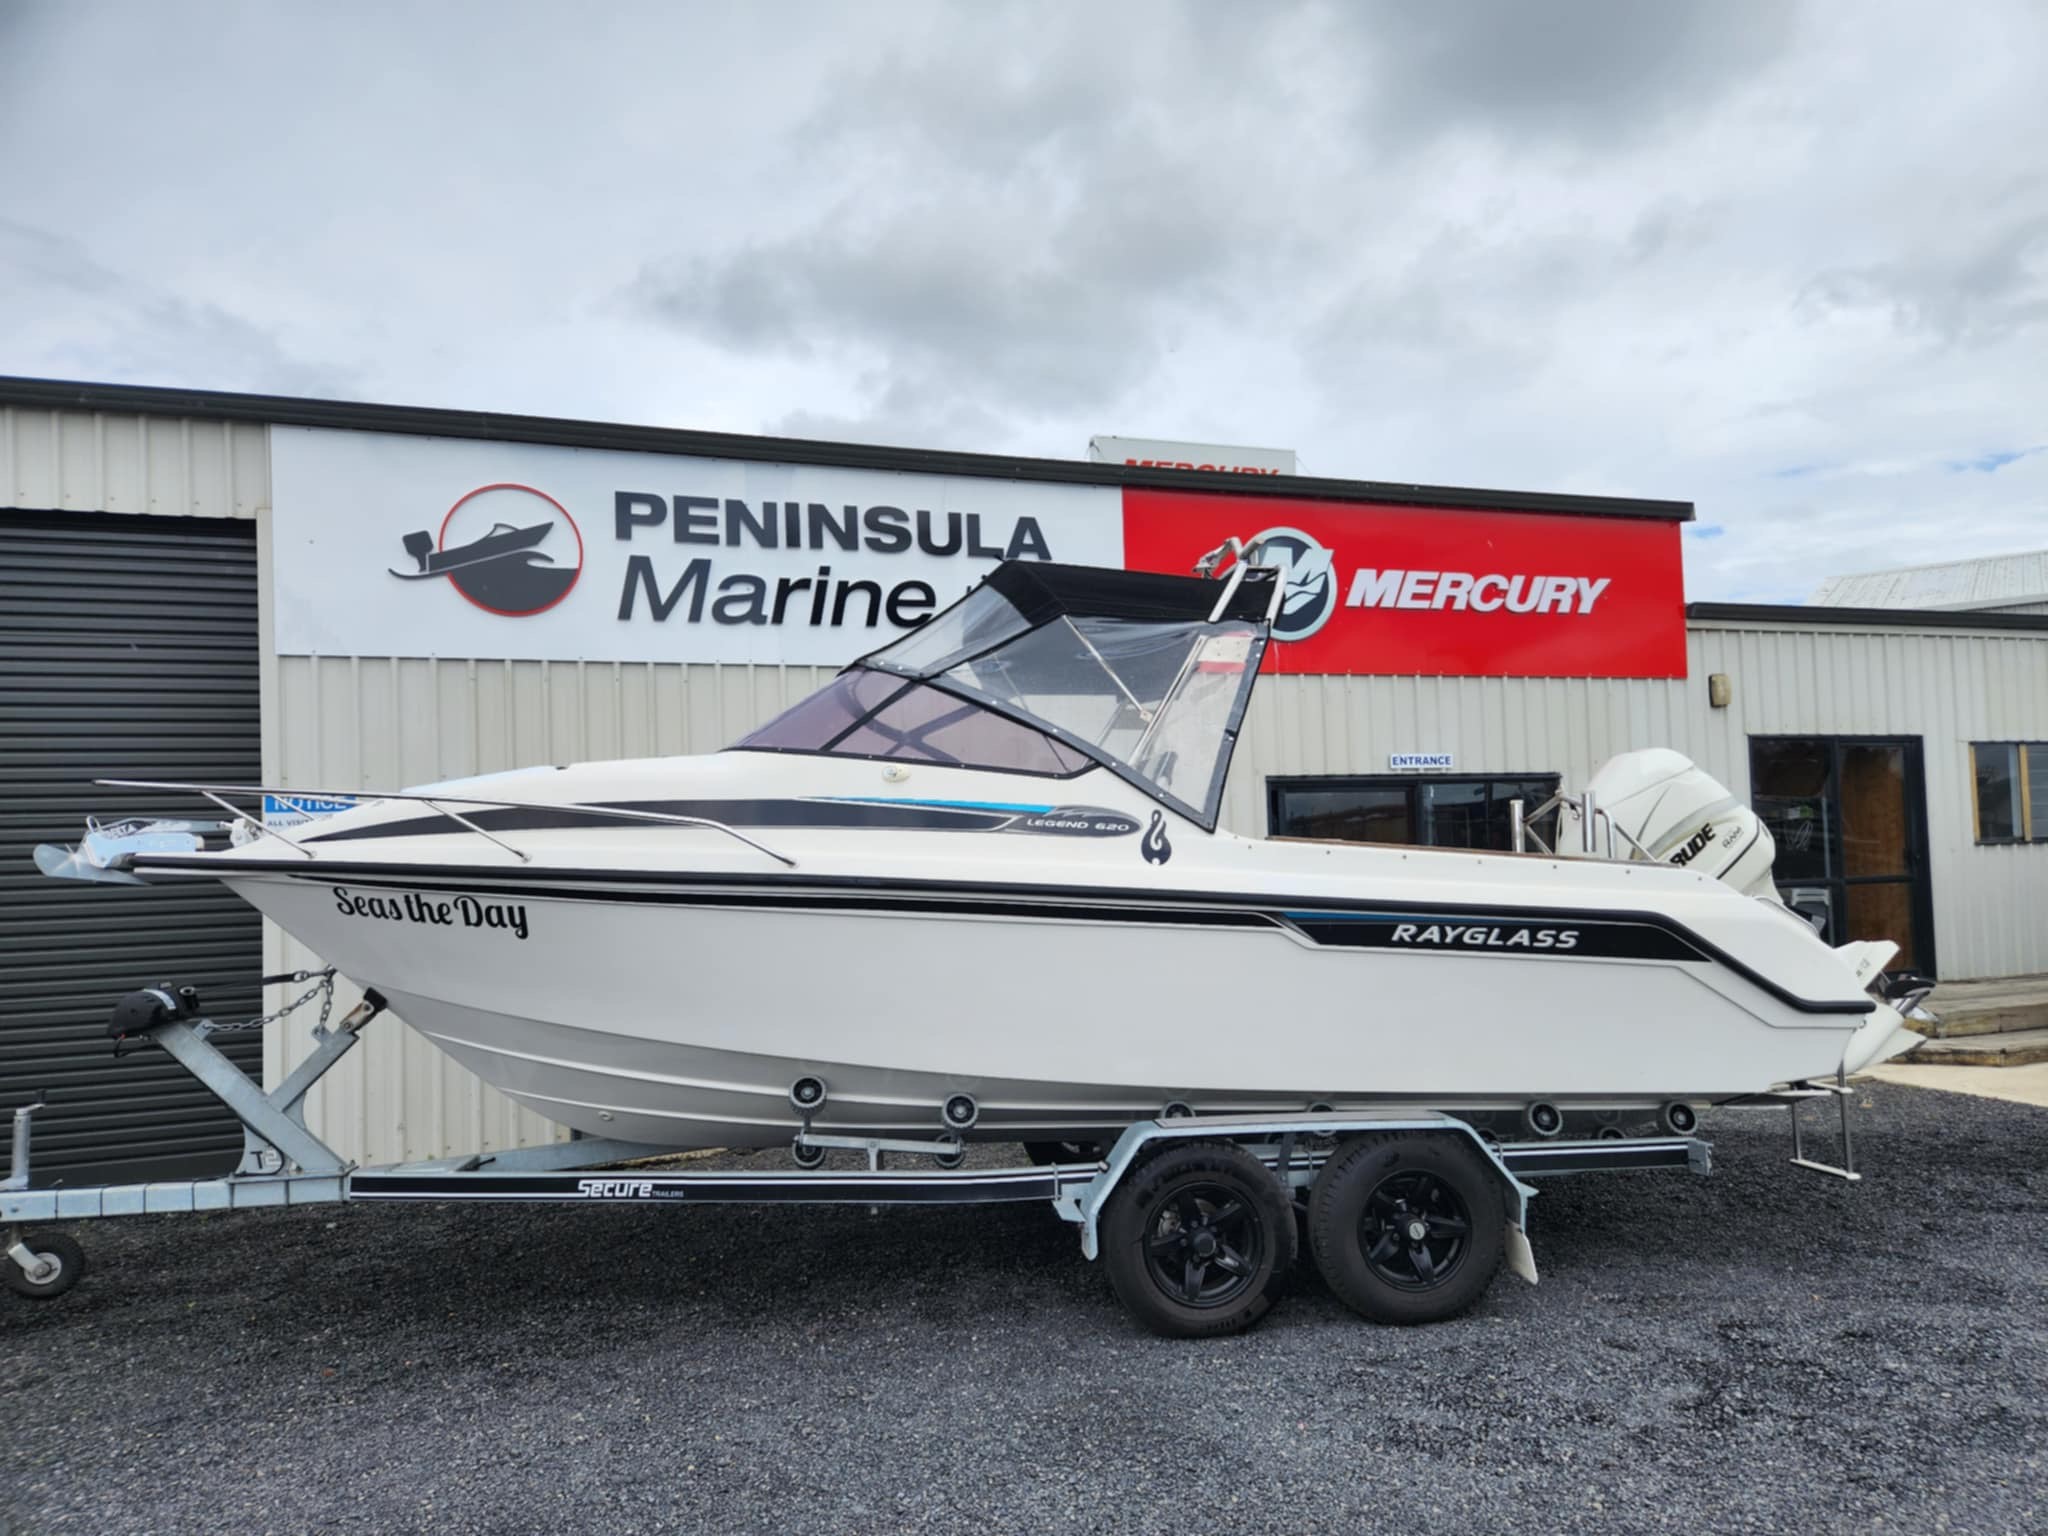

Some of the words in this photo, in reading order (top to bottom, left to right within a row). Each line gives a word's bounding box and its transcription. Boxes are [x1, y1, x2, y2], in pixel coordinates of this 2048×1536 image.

[614, 491, 1052, 561] PENINSULA
[617, 554, 937, 629] Marine
[1345, 568, 1611, 614] MERCURY
[1392, 755, 1452, 766] ENTRANCE
[1026, 818, 1089, 829] LEGEND
[1094, 820, 1130, 832] 620
[332, 886, 404, 920] Seas
[404, 893, 454, 925] the
[453, 895, 529, 940] Day
[1391, 923, 1580, 948] RAYGLASS
[577, 1178, 653, 1199] Secure
[652, 1189, 685, 1198] TRAILERS
